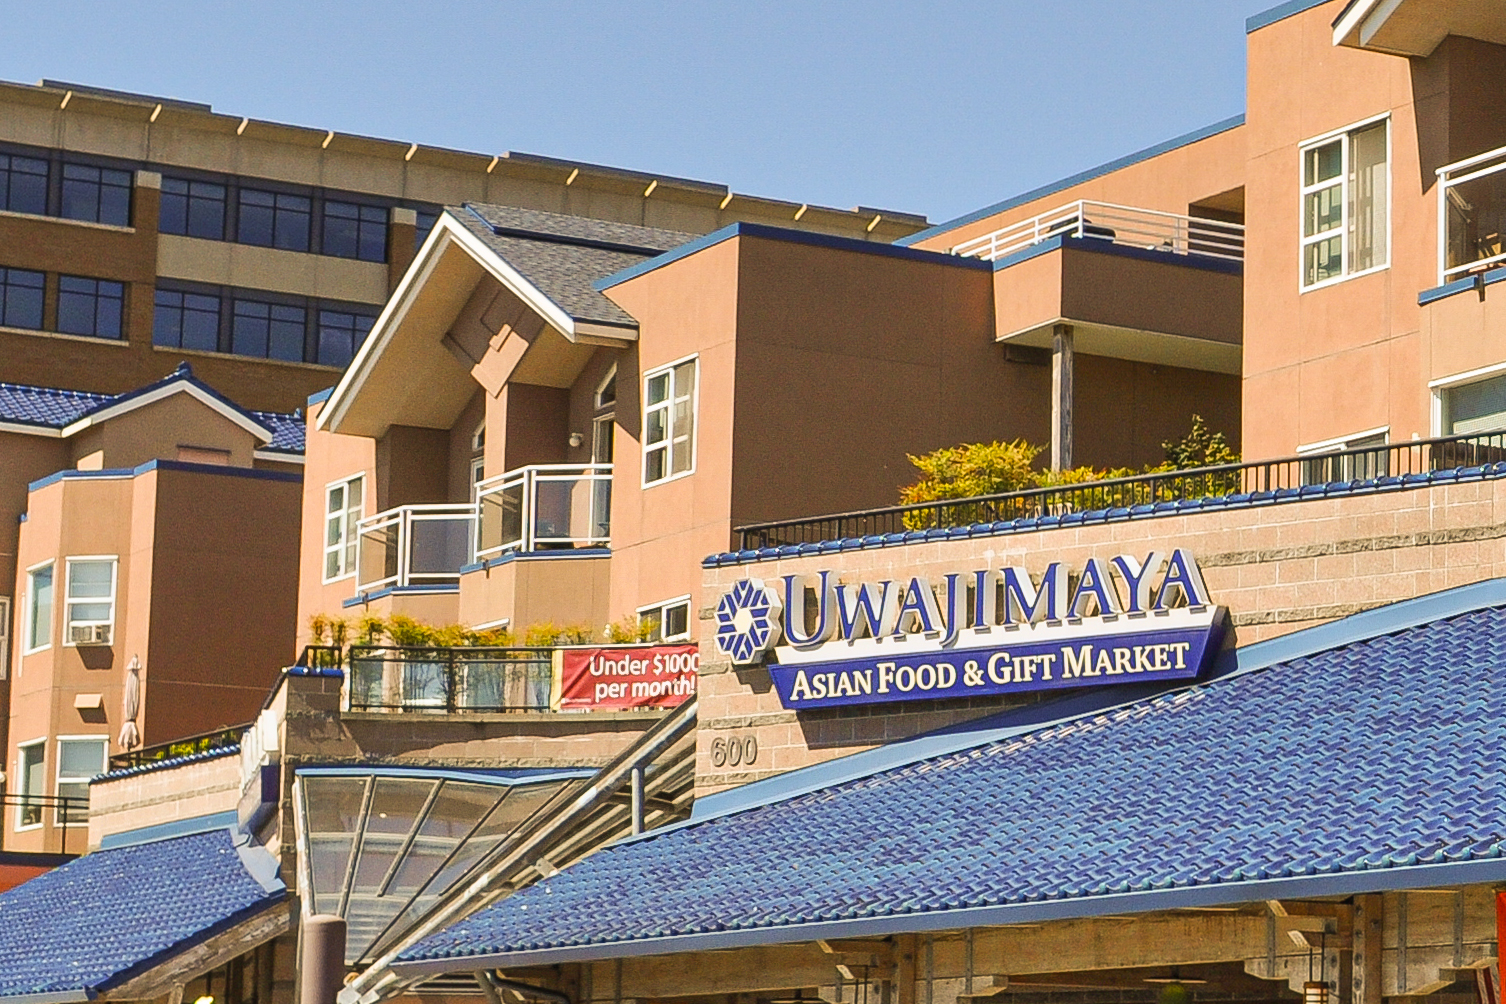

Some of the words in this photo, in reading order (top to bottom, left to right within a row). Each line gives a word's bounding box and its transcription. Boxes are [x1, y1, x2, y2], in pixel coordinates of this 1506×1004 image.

[780, 549, 1212, 648] UWAJIMAYA
[589, 654, 650, 676] Under
[790, 669, 874, 702] ASIAN
[876, 660, 957, 694] FOOD
[962, 662, 986, 687] &
[986, 651, 1056, 685] GIFT
[1059, 640, 1191, 681] MARKET
[595, 679, 628, 703] per
[631, 675, 696, 698] month!
[708, 734, 758, 767] 600
